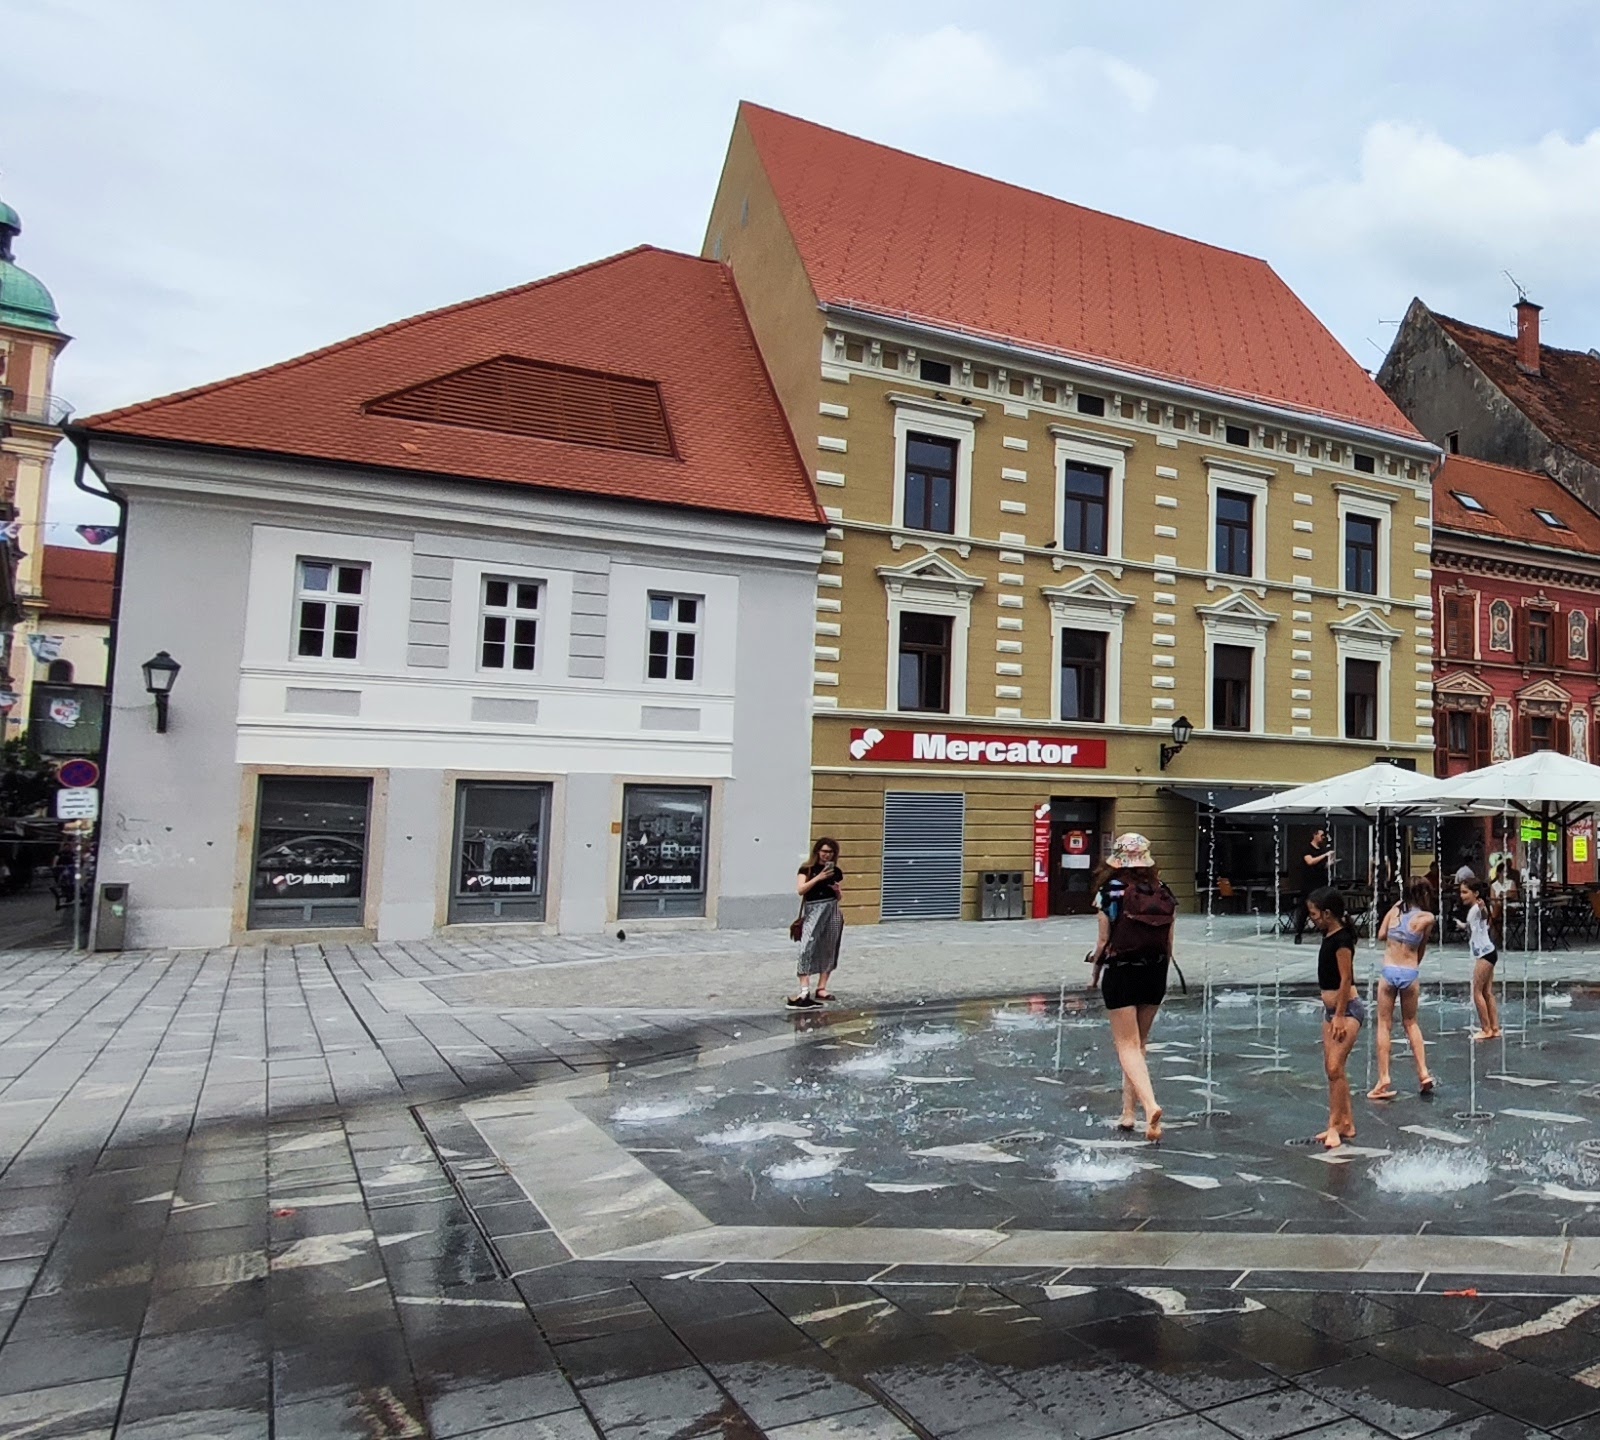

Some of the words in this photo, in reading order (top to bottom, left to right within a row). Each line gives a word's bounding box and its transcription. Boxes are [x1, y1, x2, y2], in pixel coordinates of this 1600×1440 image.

[912, 733, 1078, 764] Mercator
[303, 874, 346, 884] MARIBOR
[493, 876, 531, 885] MARIBOR
[658, 875, 692, 884] MARIBOR
